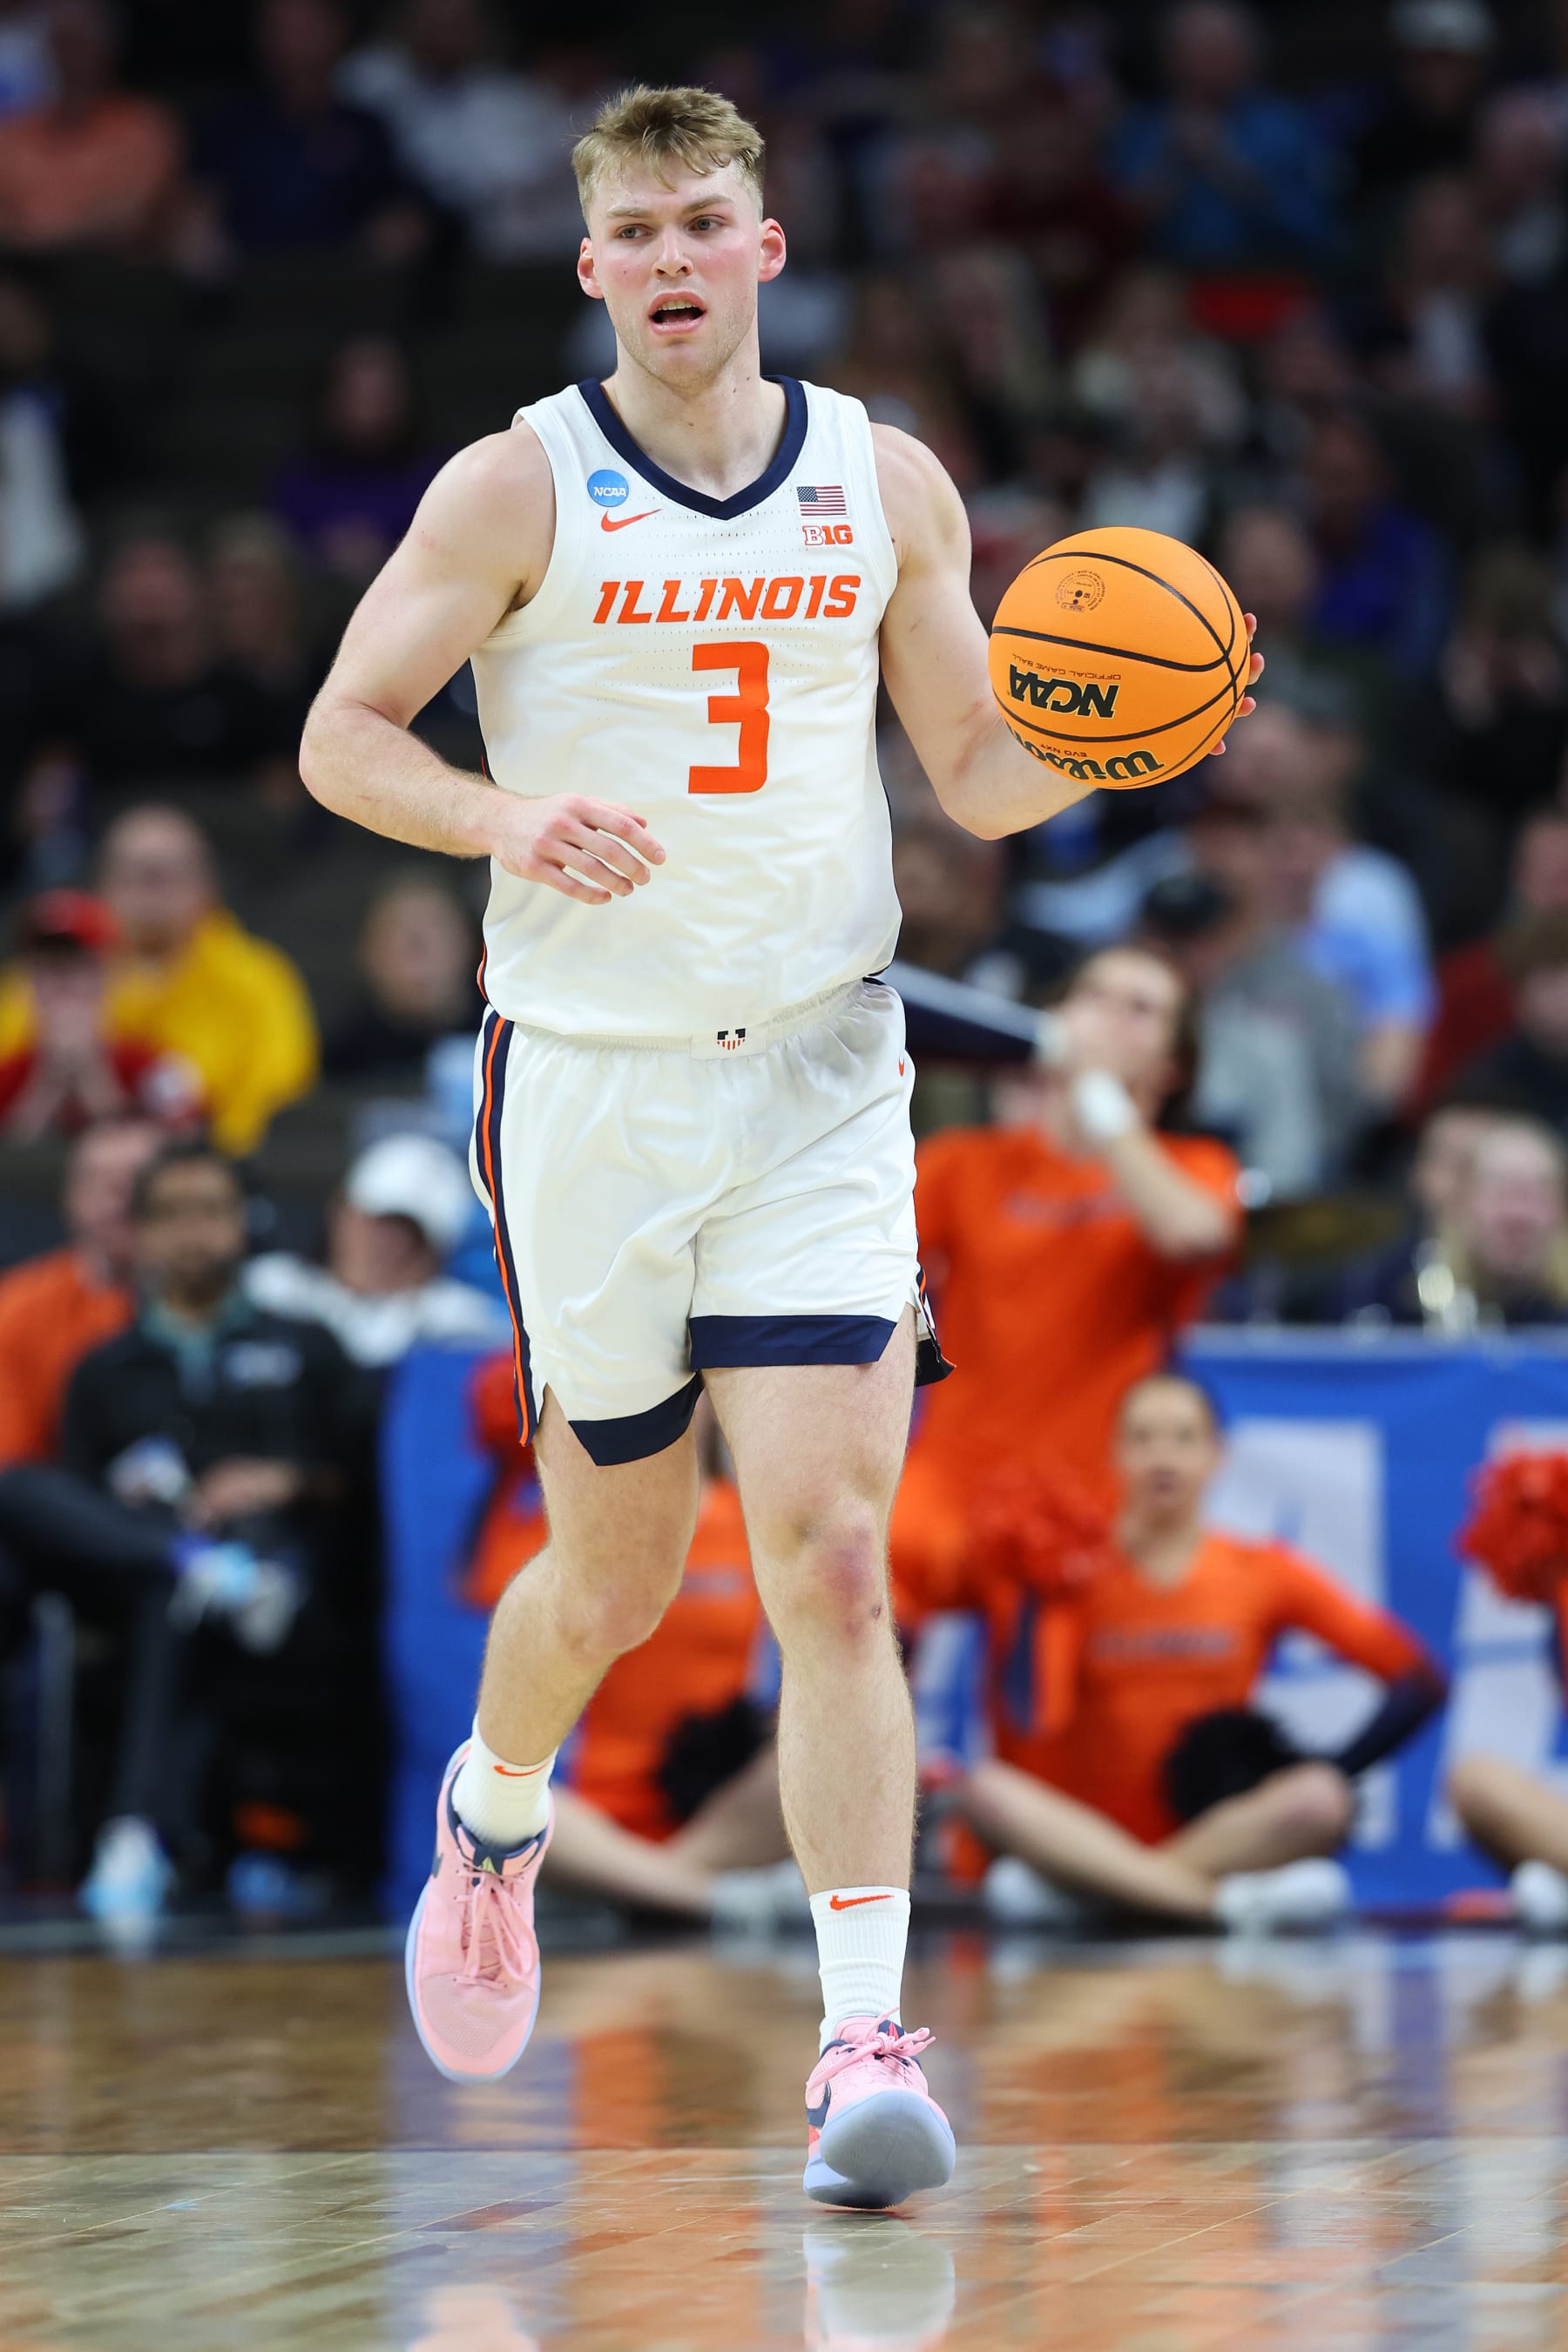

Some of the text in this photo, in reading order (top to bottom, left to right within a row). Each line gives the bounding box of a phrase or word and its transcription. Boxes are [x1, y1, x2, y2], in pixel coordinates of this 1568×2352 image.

[593, 486, 626, 497] NCAA
[592, 575, 862, 624] ILLINOIS
[1012, 653, 1121, 680] OFFICIAL GAME BALL
[1010, 663, 1119, 719] NCAA
[688, 641, 770, 794] 3
[1040, 743, 1061, 754] NXT
